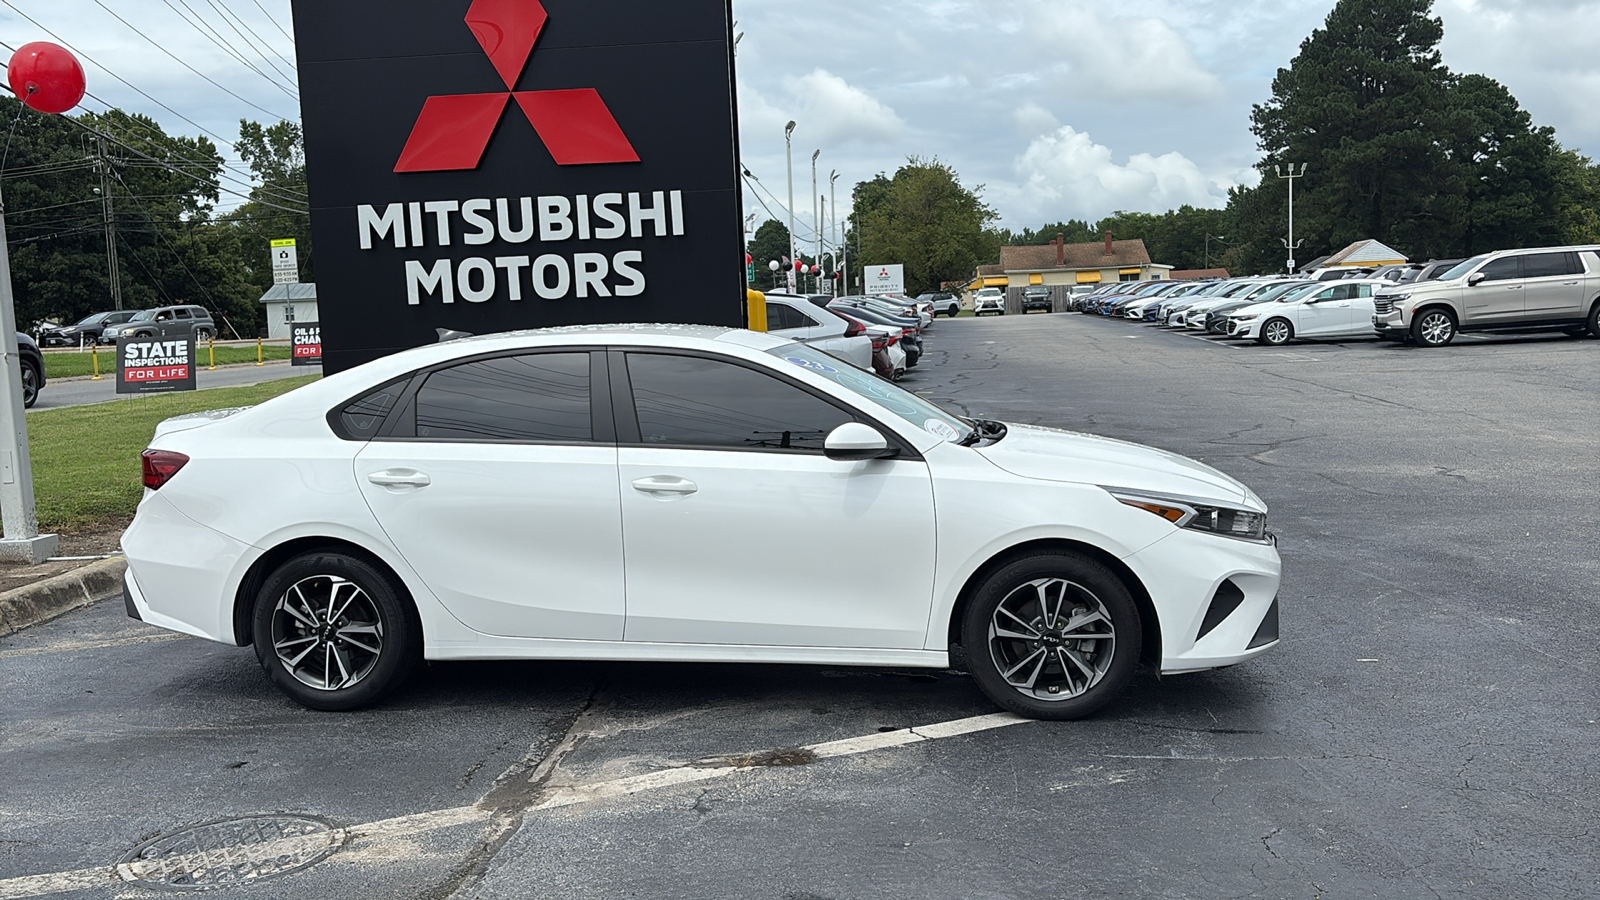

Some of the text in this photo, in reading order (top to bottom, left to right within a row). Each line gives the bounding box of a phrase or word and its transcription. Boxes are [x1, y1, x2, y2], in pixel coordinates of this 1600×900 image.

[357, 190, 684, 249] MITSUBISHI
[405, 250, 646, 305] MOTORS
[294, 328, 308, 336] OIL
[309, 327, 315, 335] &
[294, 335, 321, 345] CHAN
[125, 340, 188, 358] STATE
[297, 347, 316, 355] FOR
[125, 356, 188, 367] INSPECTIONS
[128, 368, 185, 379] FOR LIFE
